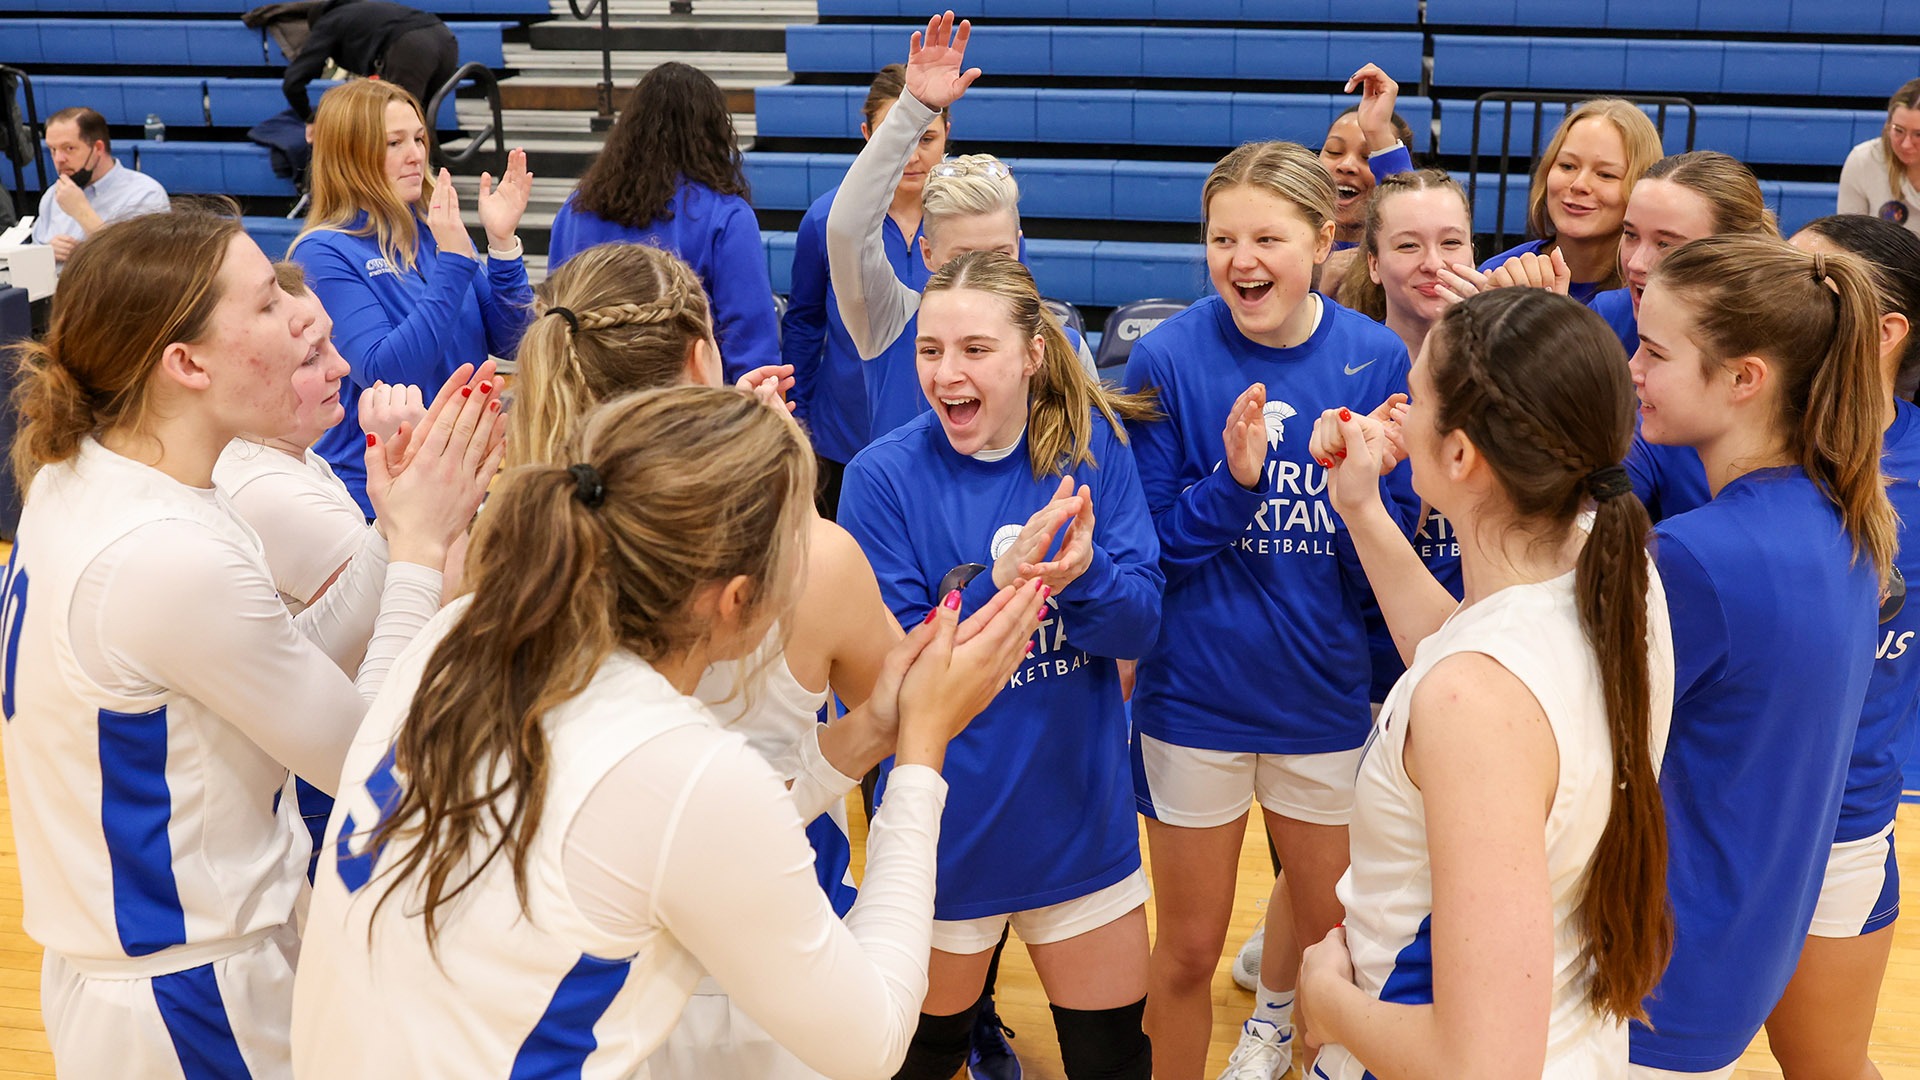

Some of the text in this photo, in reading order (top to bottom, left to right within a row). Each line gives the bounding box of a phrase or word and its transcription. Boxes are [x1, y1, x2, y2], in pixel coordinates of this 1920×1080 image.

[1246, 498, 1336, 534] RTAN
[1230, 537, 1335, 556] KETBALL
[1010, 651, 1090, 689] KETBAL
